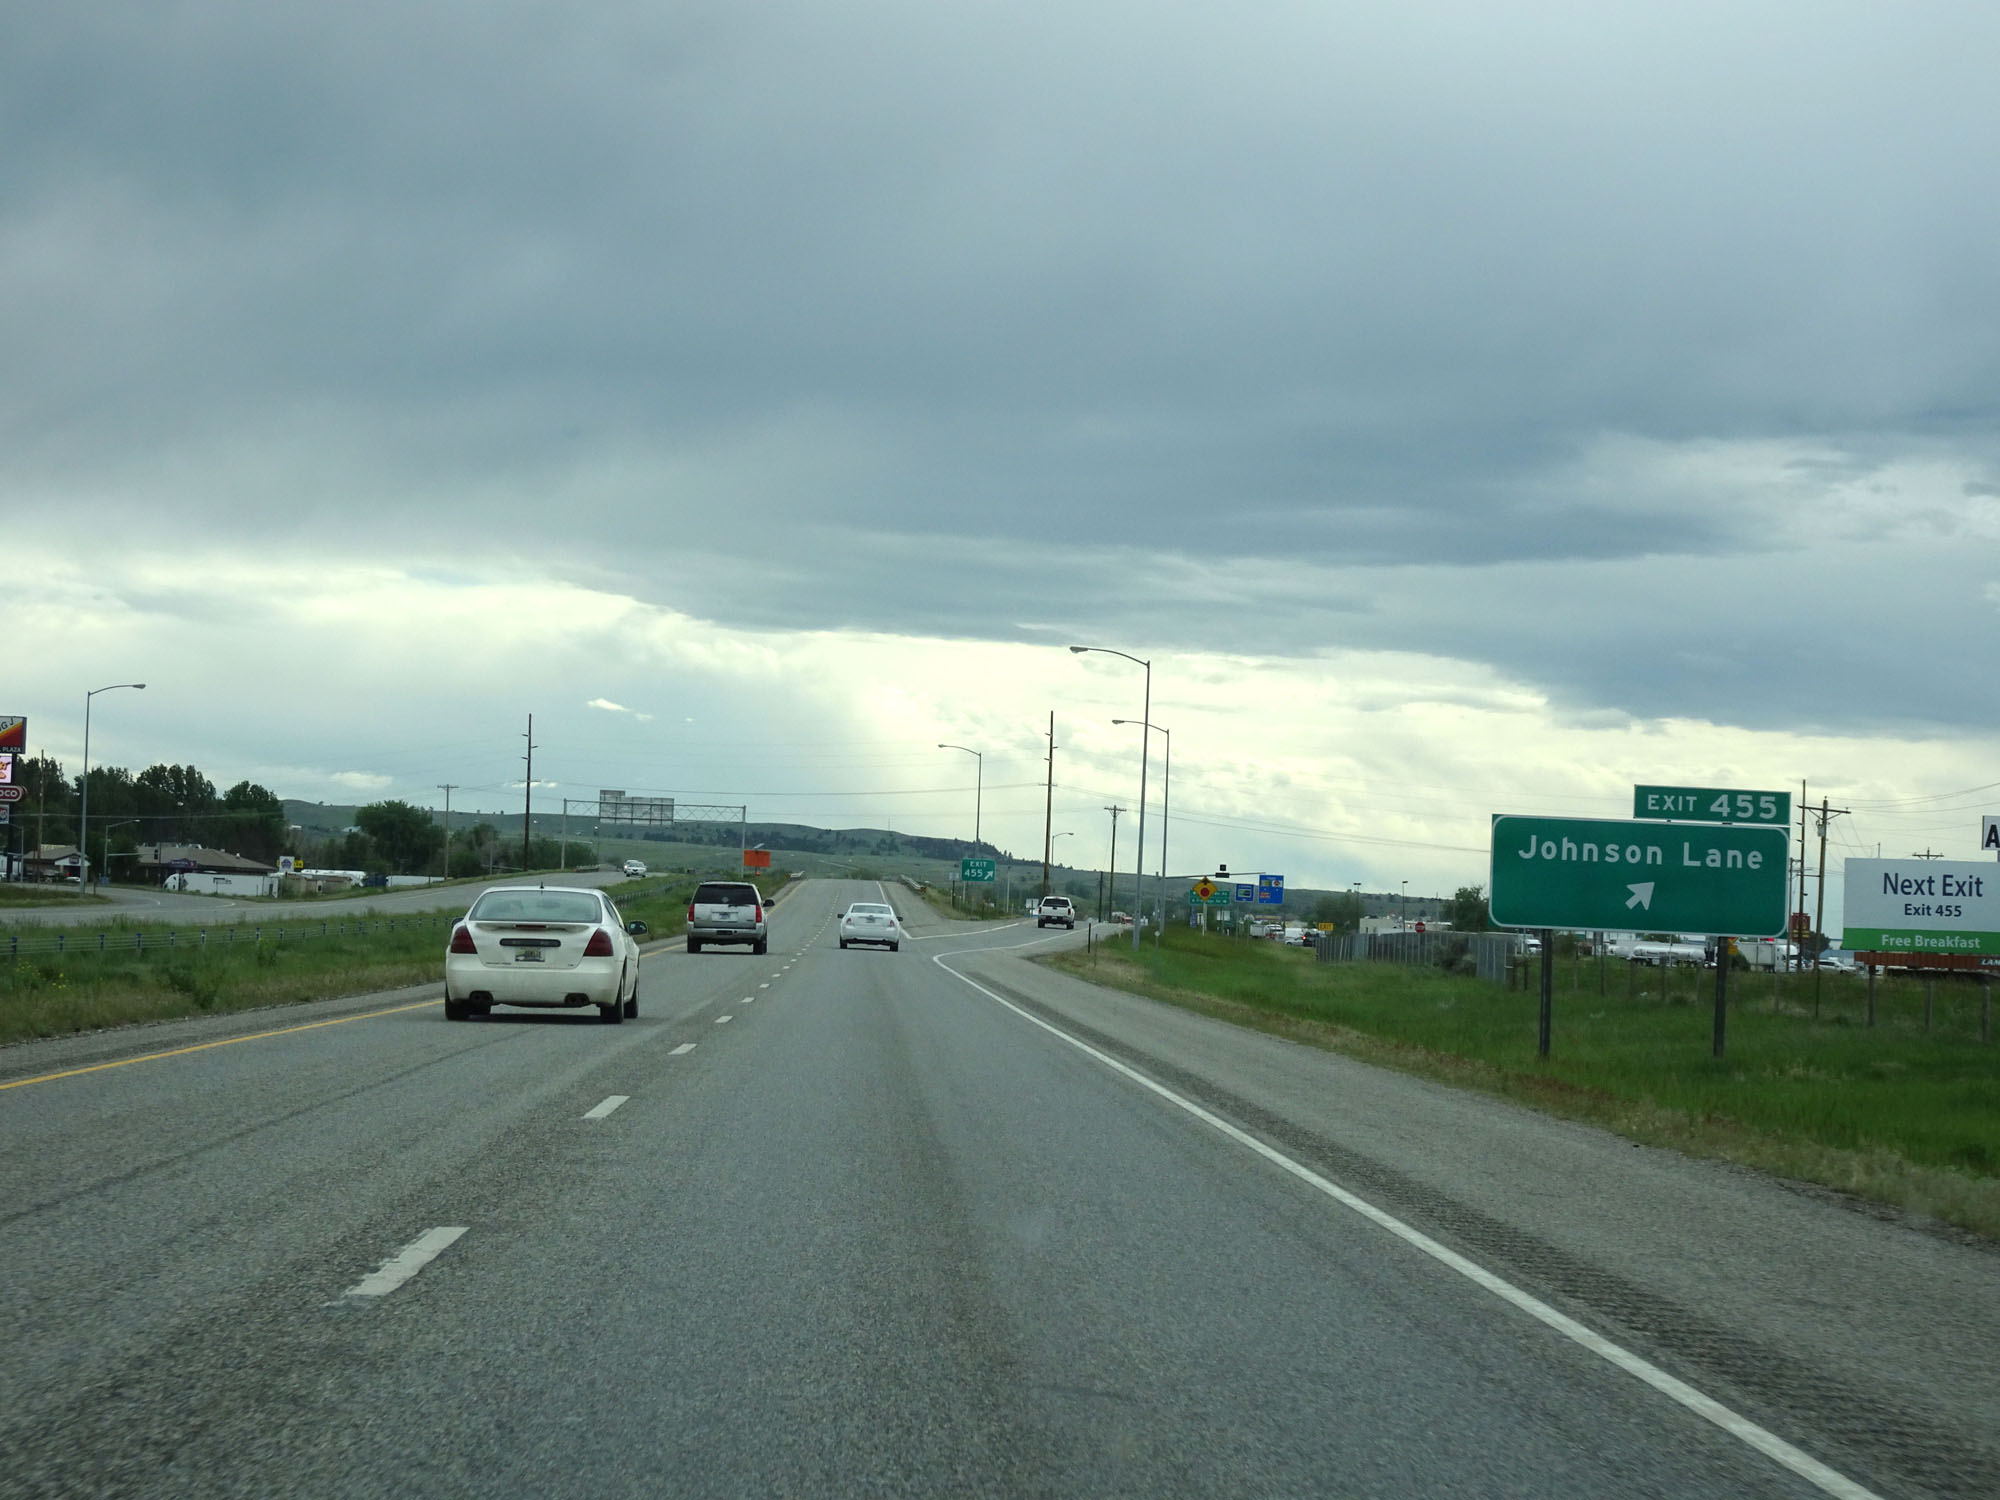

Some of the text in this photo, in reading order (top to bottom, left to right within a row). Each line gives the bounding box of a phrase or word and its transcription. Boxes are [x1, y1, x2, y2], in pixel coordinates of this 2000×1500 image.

[1647, 794, 1777, 819] EXIT 455
[1518, 835, 1763, 870] Johnson Lane
[964, 869, 983, 877] 455
[1883, 872, 1984, 897] Next Exit
[1904, 903, 1962, 917] Exit 455
[1881, 934, 1981, 948] Free Breakfast
